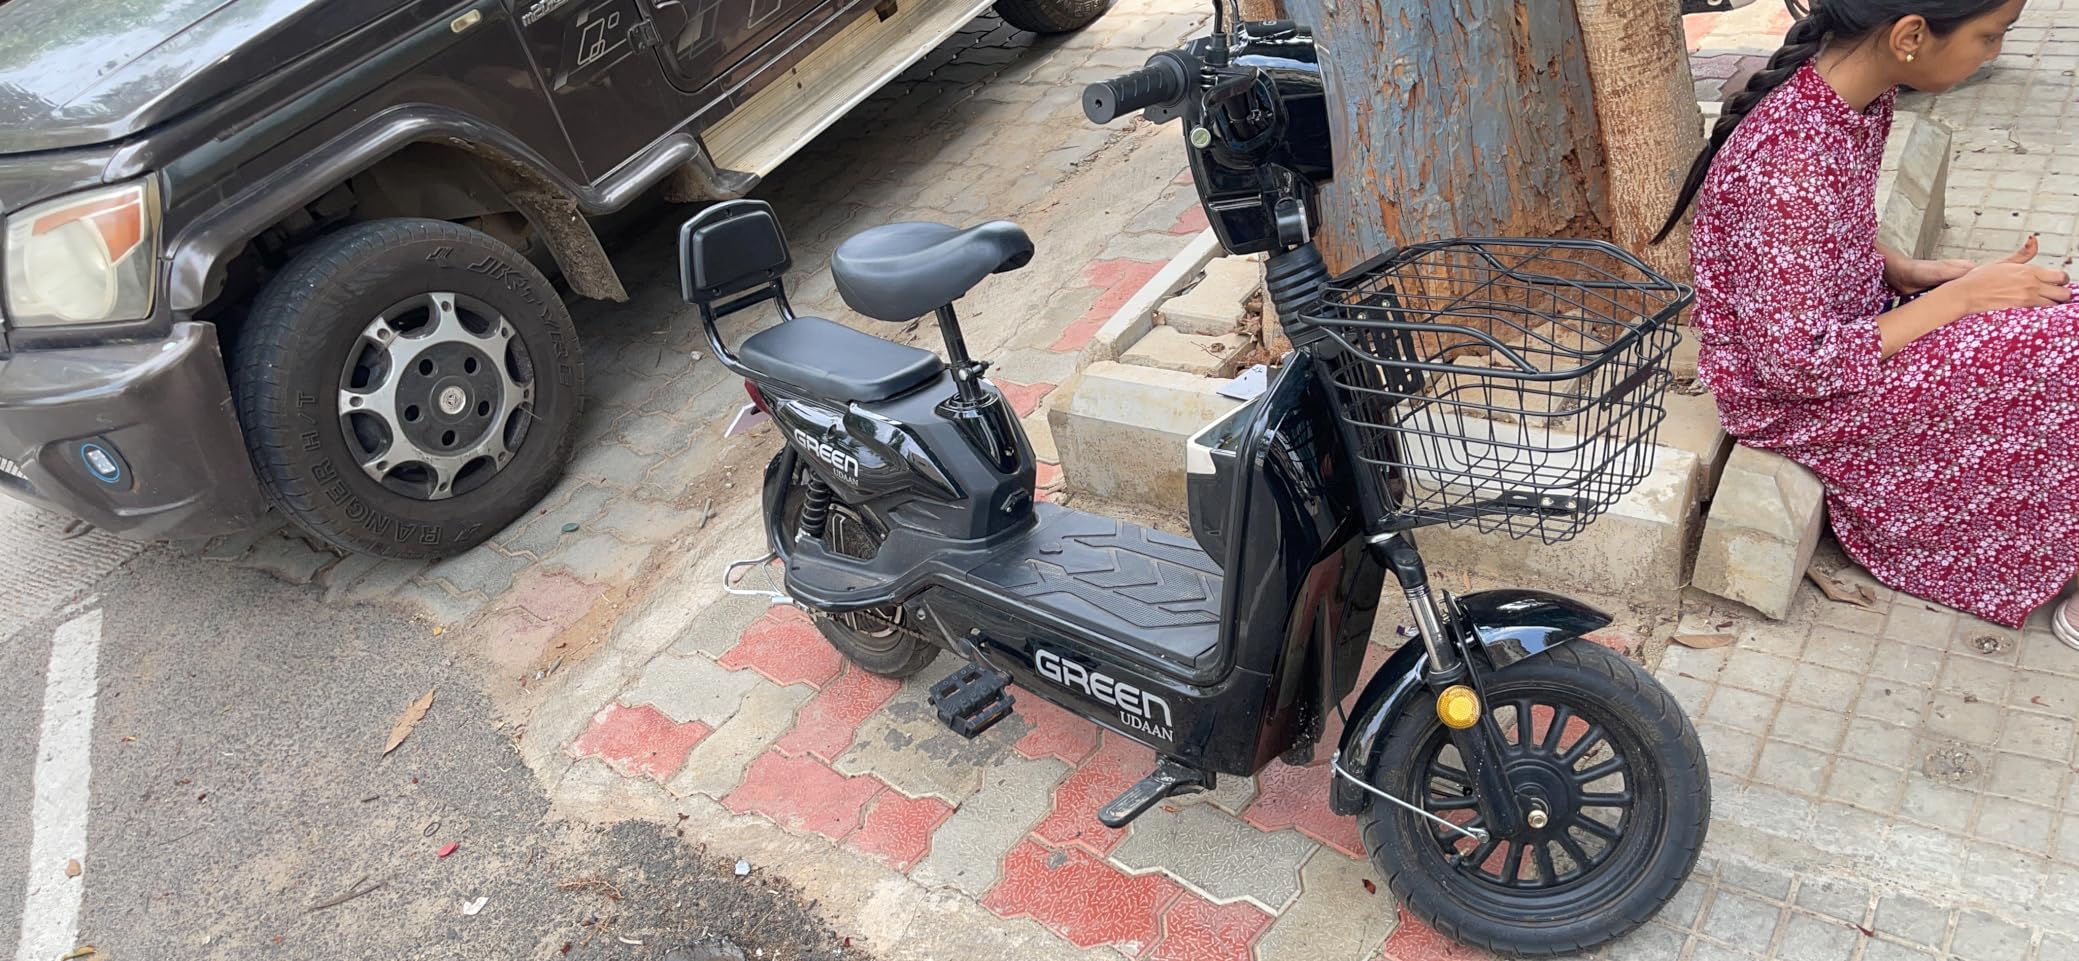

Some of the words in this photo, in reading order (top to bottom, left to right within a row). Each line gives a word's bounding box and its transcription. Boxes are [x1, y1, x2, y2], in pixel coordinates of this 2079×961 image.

[297, 392, 321, 451] H/T
[794, 428, 858, 477] GREEN
[833, 468, 858, 486] UDAAN
[312, 457, 442, 545] RANGER
[1035, 649, 1172, 727] GREEN
[1119, 711, 1173, 742] UDAAN
